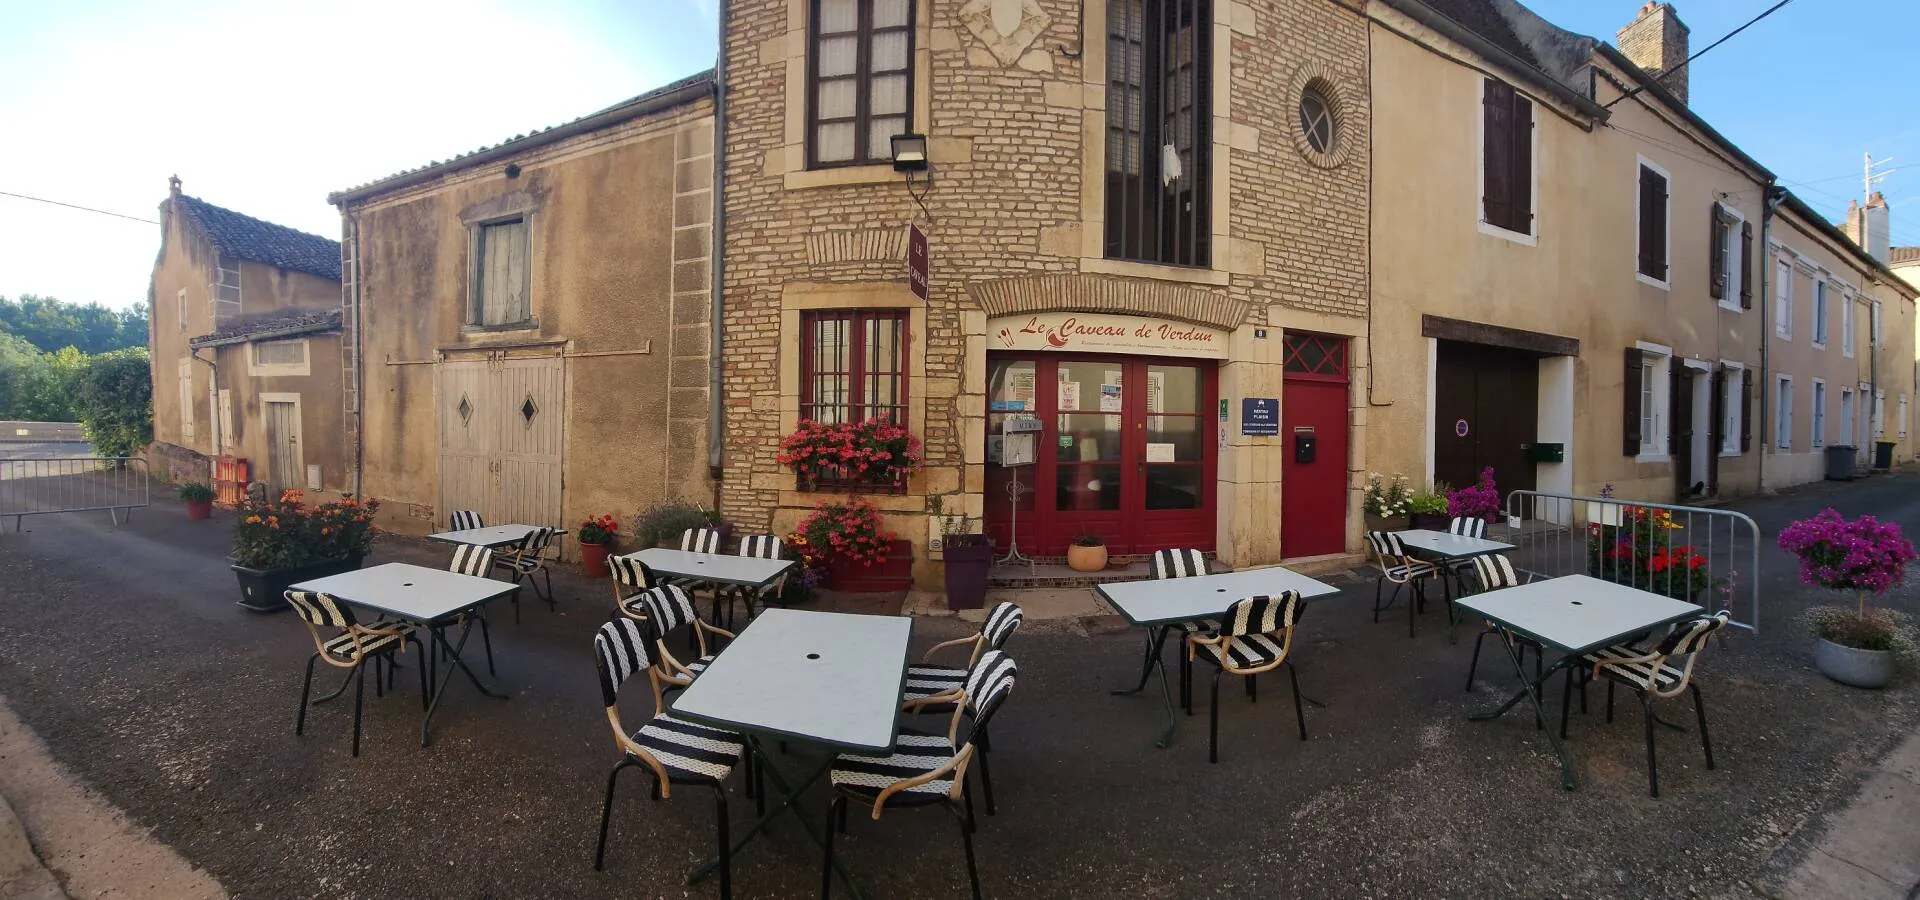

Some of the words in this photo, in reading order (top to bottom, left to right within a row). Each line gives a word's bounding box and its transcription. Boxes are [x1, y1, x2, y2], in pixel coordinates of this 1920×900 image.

[915, 242, 923, 257] LE
[1019, 316, 1046, 334] Le
[1060, 317, 1126, 337] Caveau
[1134, 323, 1151, 338] de
[1157, 323, 1213, 341] Verdun
